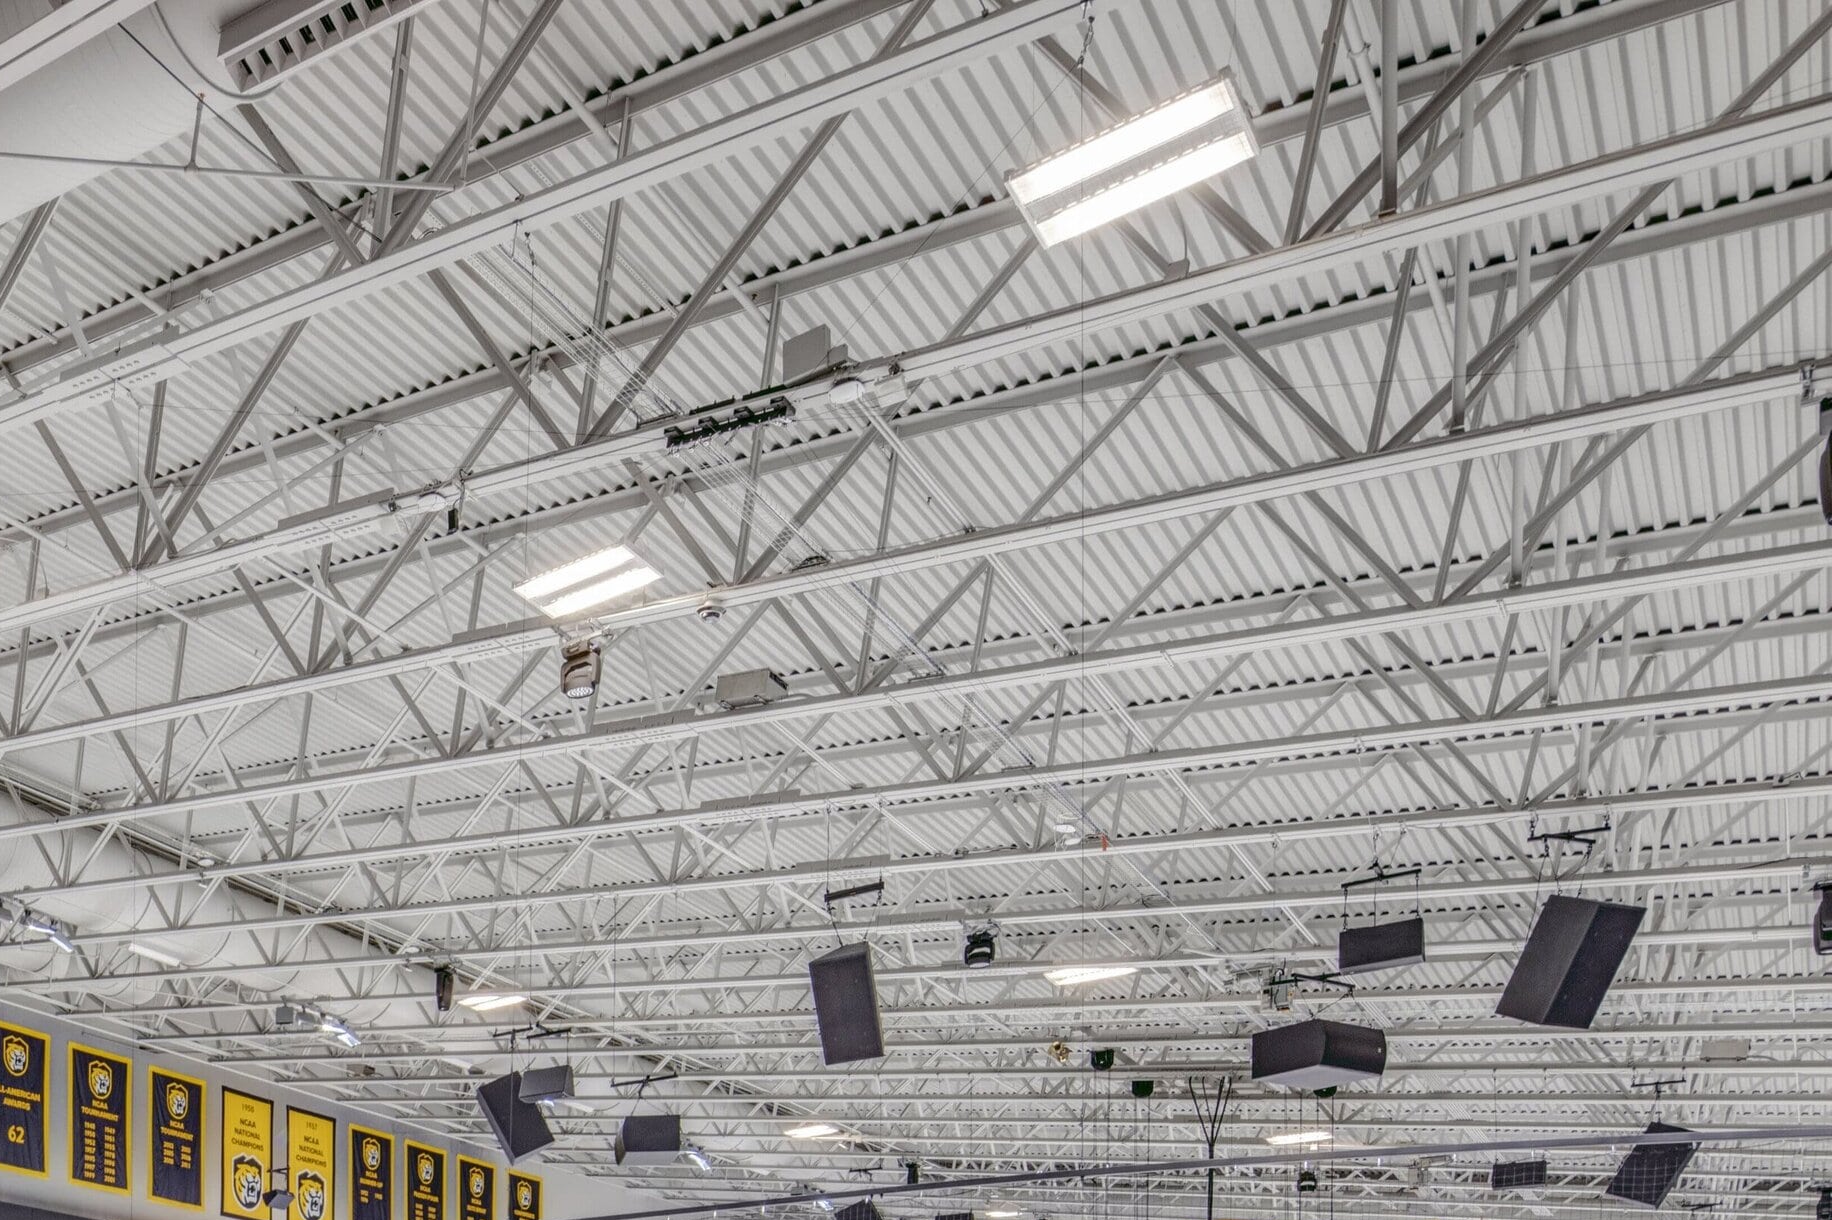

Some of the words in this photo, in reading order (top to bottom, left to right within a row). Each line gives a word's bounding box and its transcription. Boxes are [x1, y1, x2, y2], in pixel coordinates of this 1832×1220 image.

[3, 1098, 31, 1112] AWARDS
[92, 1100, 108, 1110] NCAA
[81, 1106, 119, 1122] TOURNAMENT
[170, 1120, 184, 1130] NCAA
[240, 1118, 257, 1129] NCAA
[7, 1125, 25, 1144] 62
[161, 1127, 193, 1141] TOURNAMENT
[234, 1127, 261, 1140] NATIONAL
[231, 1138, 264, 1152] CHAMPIONS
[304, 1136, 319, 1146] NCAA
[299, 1145, 324, 1157] NATIONAL
[296, 1155, 327, 1168] CHAMPIONS
